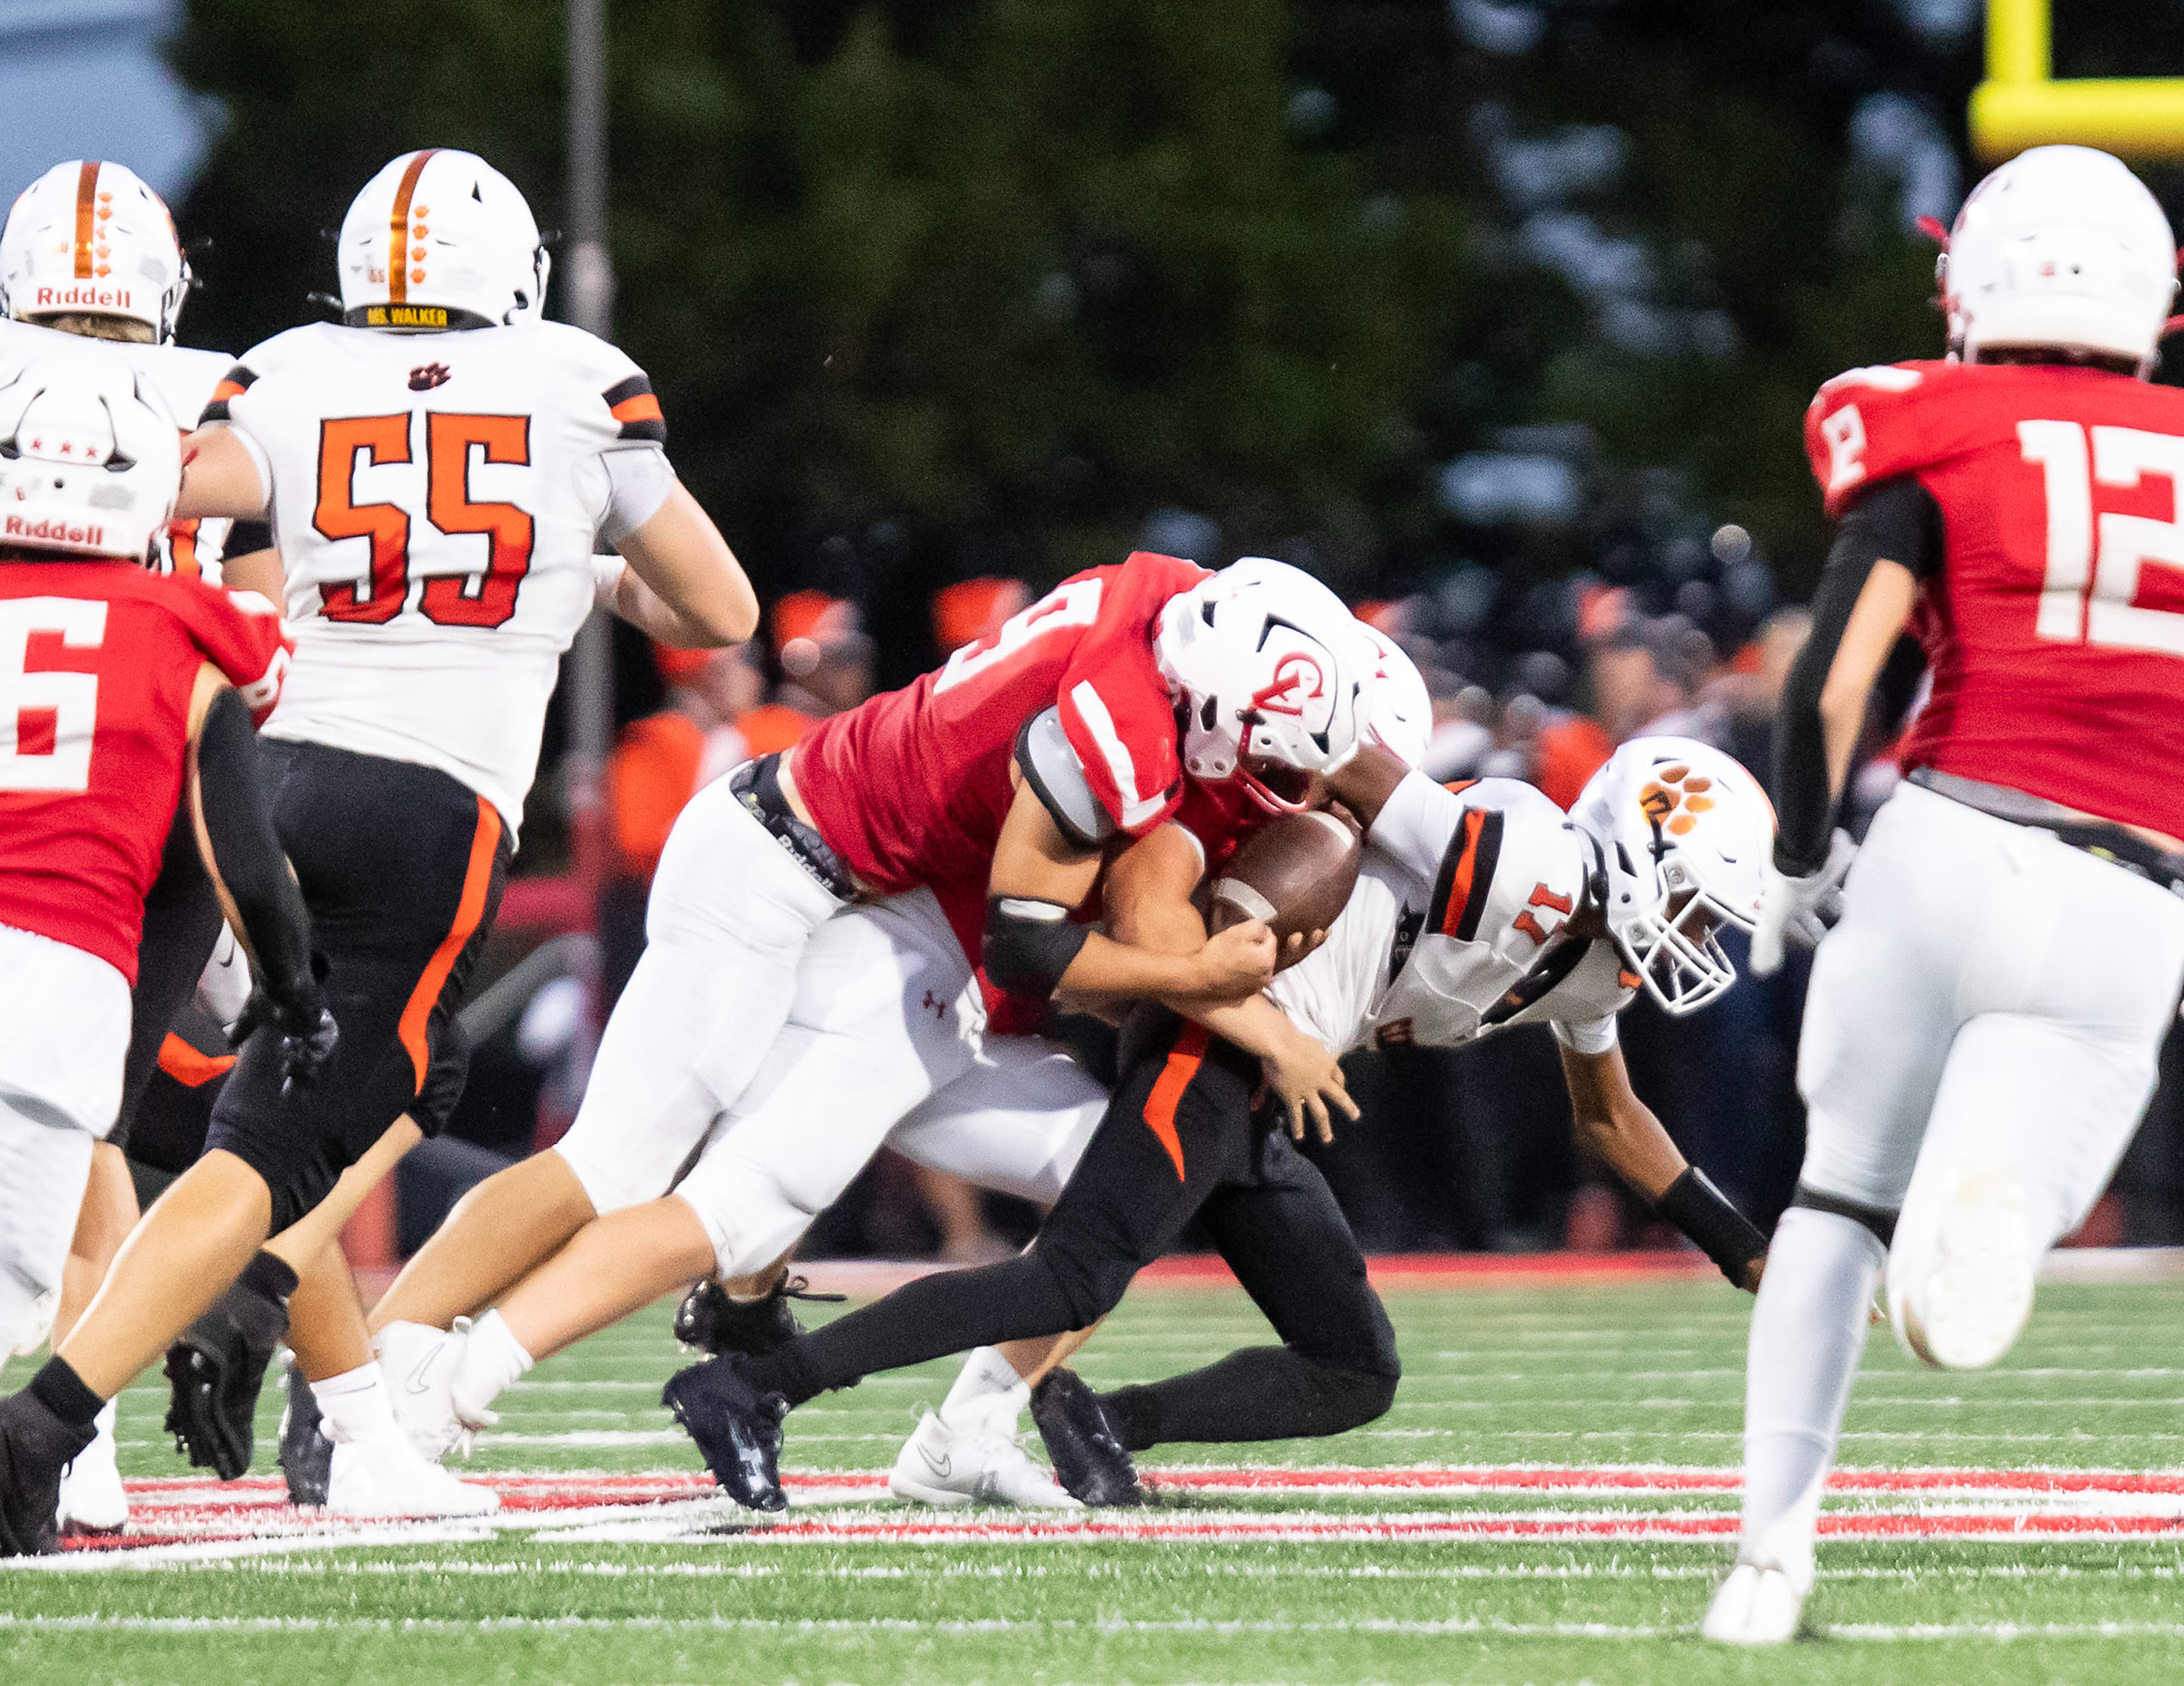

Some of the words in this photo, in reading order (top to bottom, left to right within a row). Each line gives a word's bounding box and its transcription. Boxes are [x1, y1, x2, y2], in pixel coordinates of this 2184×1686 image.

[37, 287, 131, 309] Riddell
[391, 307, 447, 327] WALKER
[6, 514, 103, 545] Riddell
[312, 411, 534, 629] 55
[2016, 419, 2184, 656] 12
